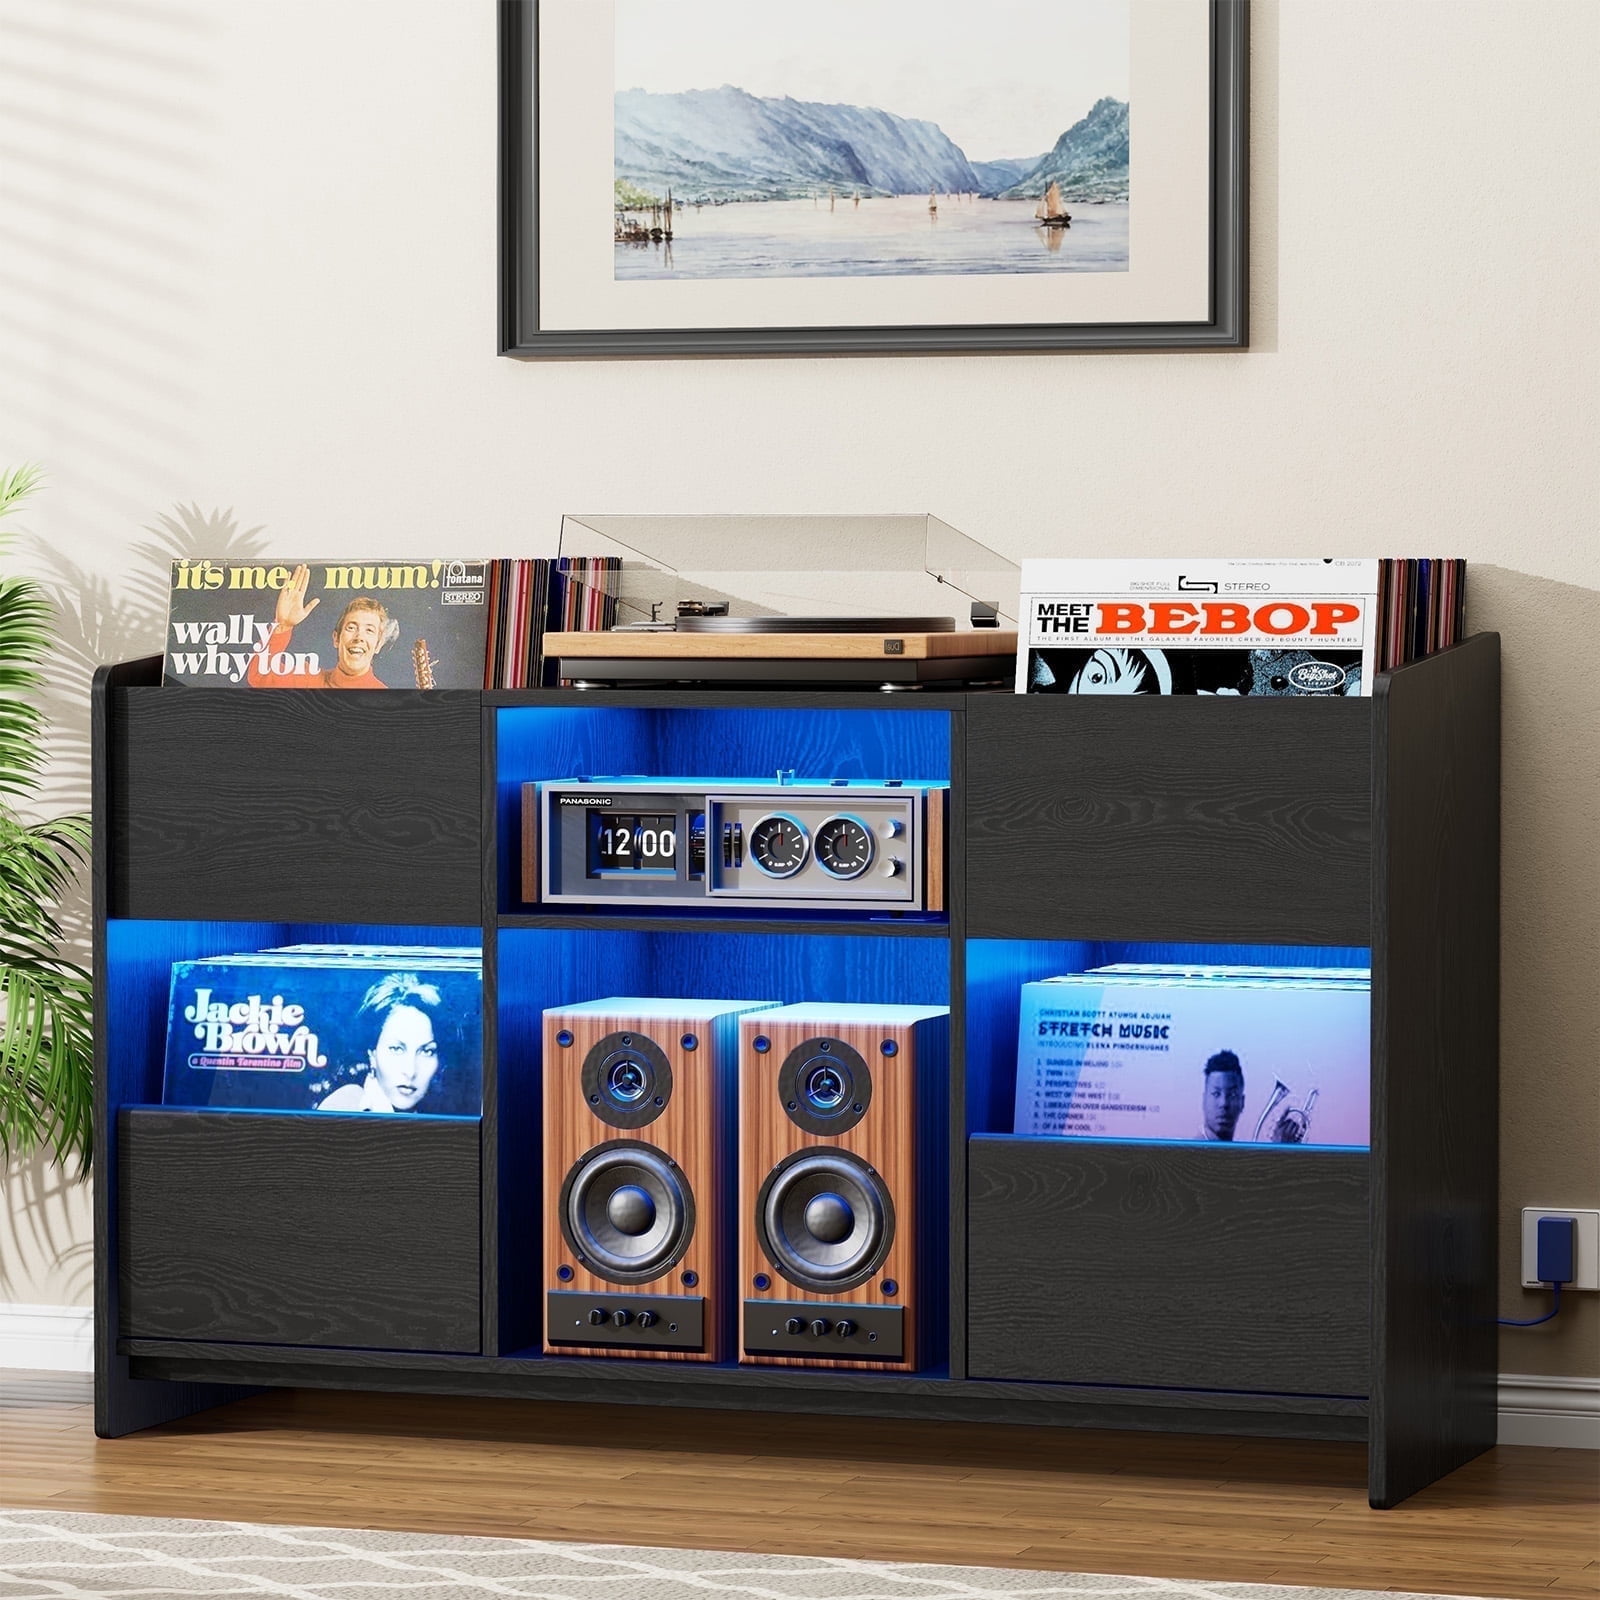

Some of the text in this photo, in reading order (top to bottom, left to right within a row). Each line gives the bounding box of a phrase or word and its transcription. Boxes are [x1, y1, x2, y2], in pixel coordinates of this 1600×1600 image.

[175, 560, 225, 590] it's
[323, 559, 442, 589] mum!
[446, 575, 483, 586] fontana
[1223, 582, 1272, 591] STEREO
[444, 591, 481, 601] STEREO
[1038, 603, 1094, 616] MEET
[1037, 617, 1090, 633] THE
[1096, 602, 1360, 635] BEBOP
[171, 614, 280, 652] wally
[170, 644, 321, 683] whyton
[604, 828, 675, 857] 12 00
[184, 988, 305, 1032] Jackie
[1039, 1009, 1080, 1018] CHRISTIAN
[1082, 1010, 1106, 1019] SCOTT
[1141, 1012, 1171, 1020] ADJUAH
[1038, 1021, 1170, 1039] STRETCH MUSIC
[194, 1021, 327, 1068] Brown
[1038, 1040, 1085, 1049] INTRODUCING
[1113, 1042, 1170, 1052] PINDERHUGHES
[200, 1056, 235, 1067] Quentin
[282, 1058, 302, 1070] film
[1045, 1080, 1092, 1089] PERSPECTIVES
[1044, 1101, 1081, 1109] LIBERATION
[1101, 1103, 1147, 1112] GANGSTERISM
[1057, 1112, 1084, 1120] CORNER
